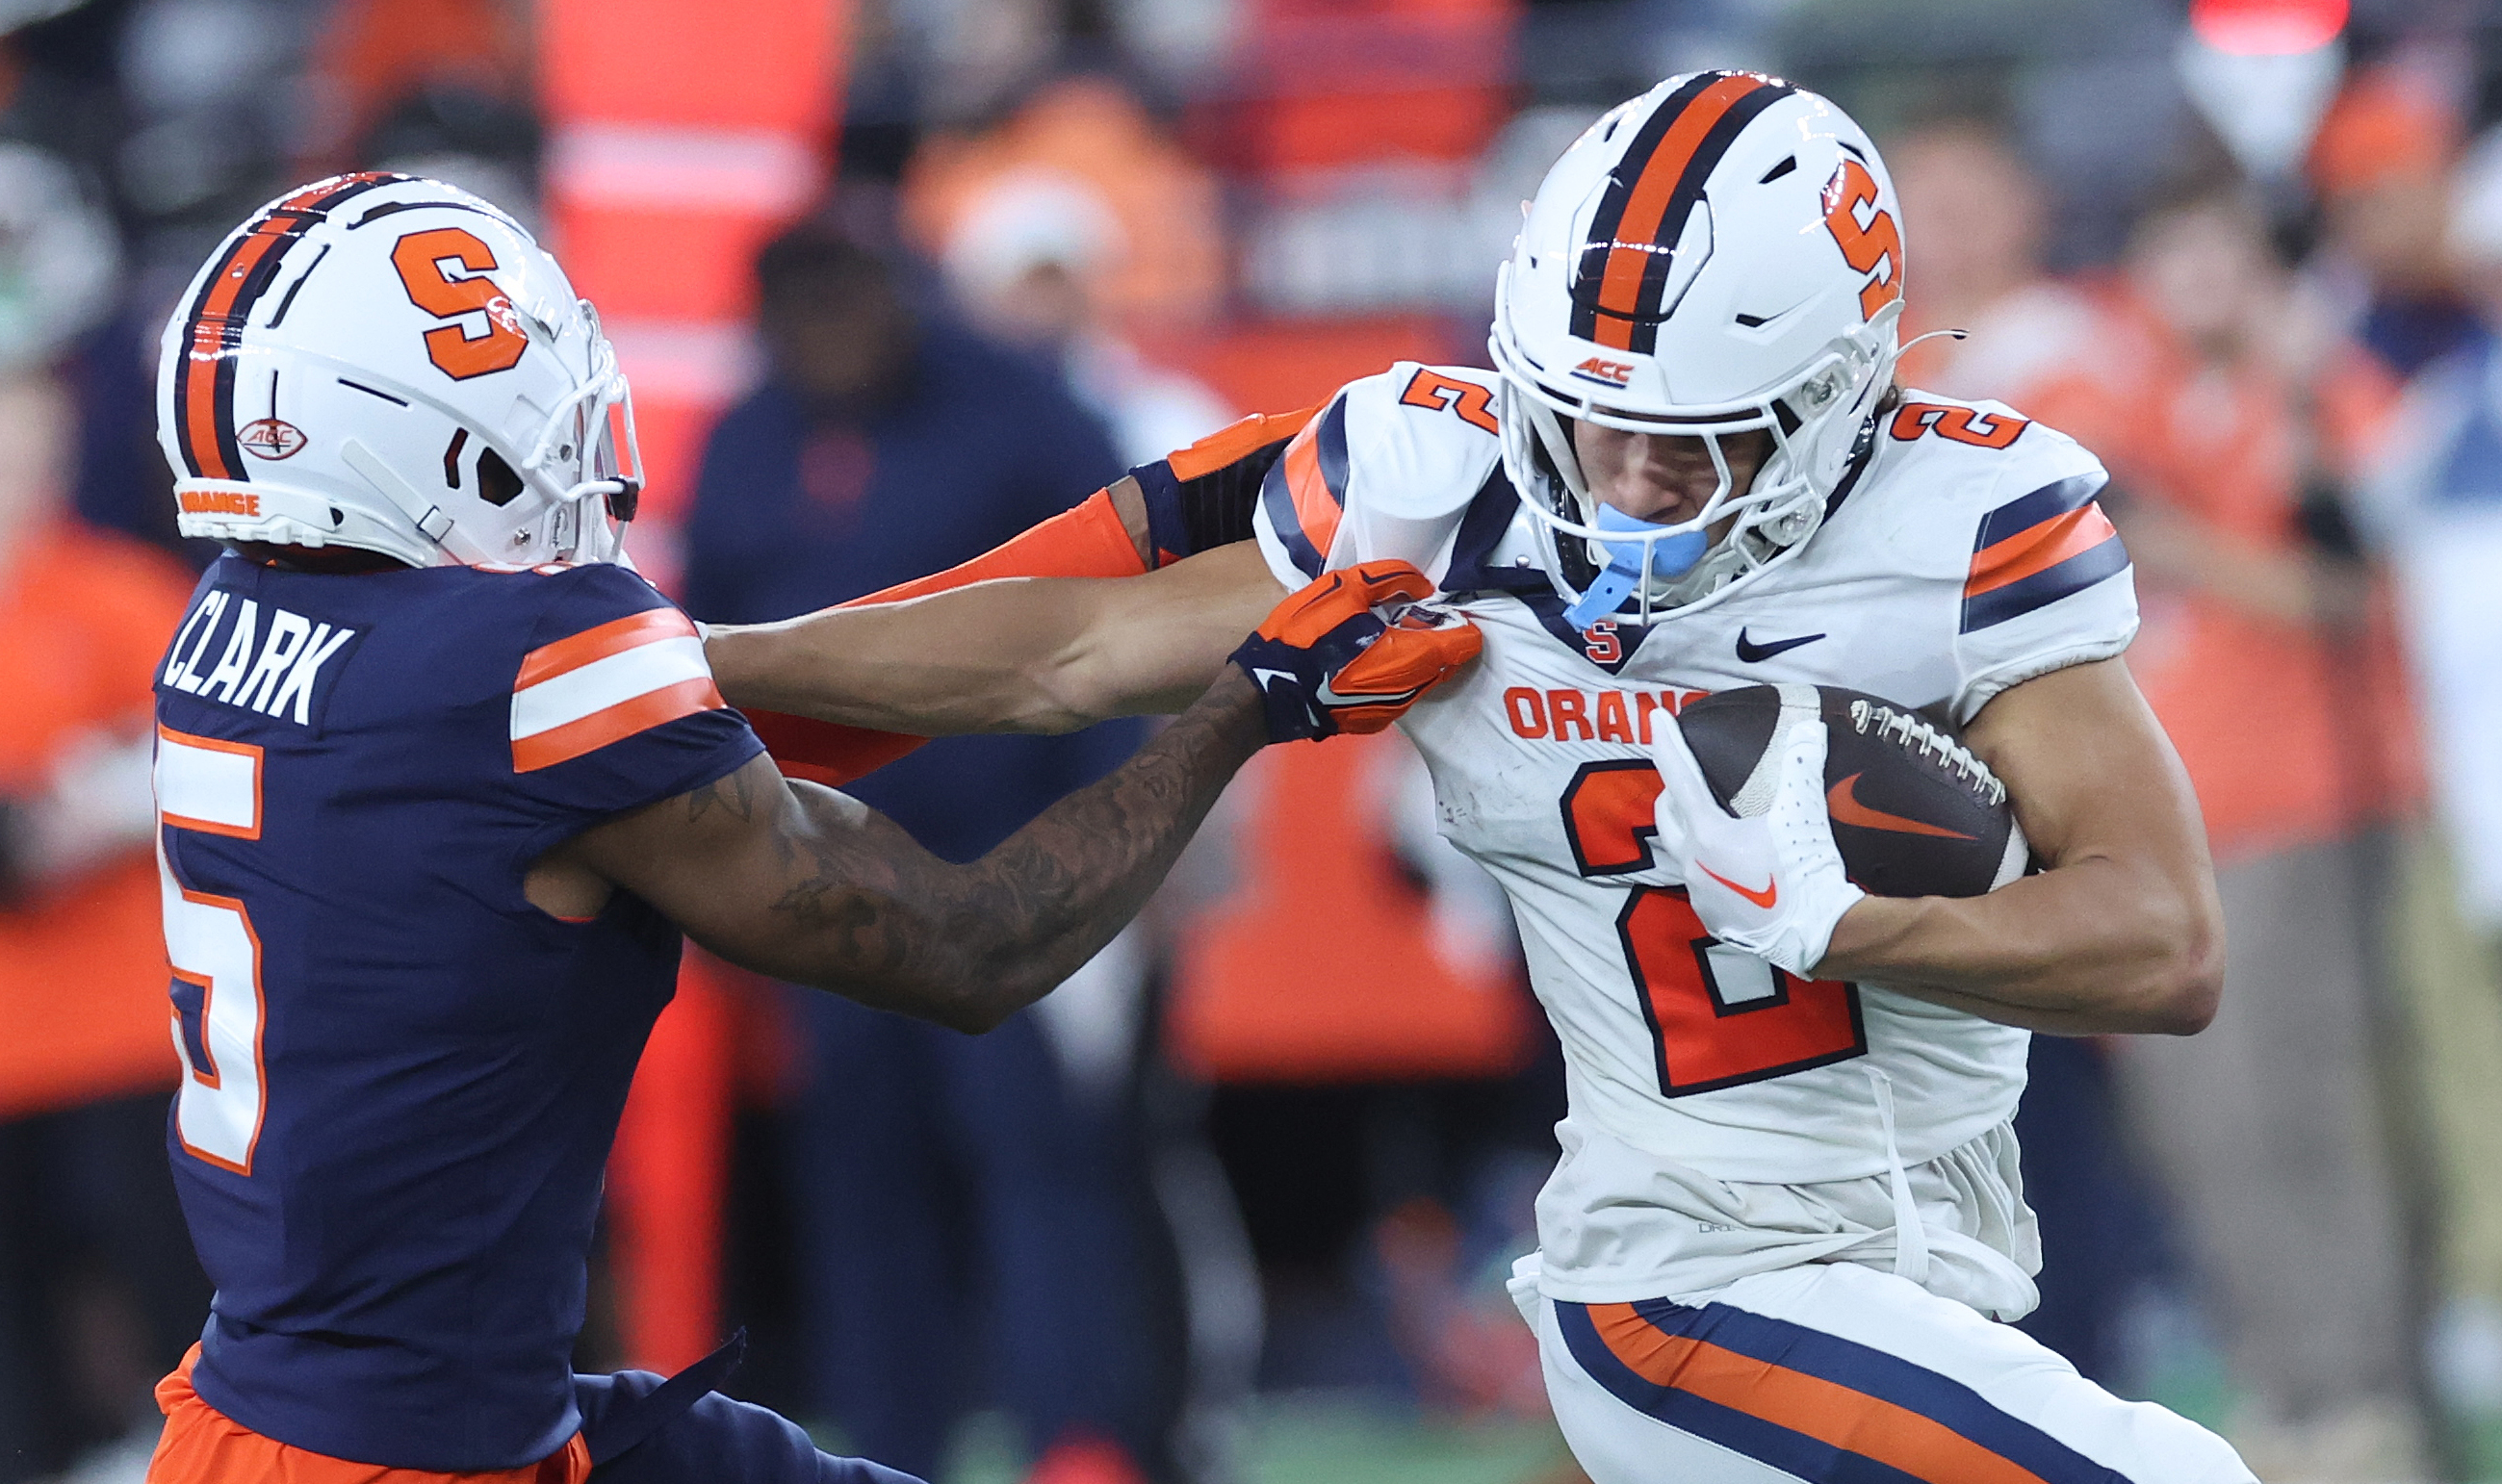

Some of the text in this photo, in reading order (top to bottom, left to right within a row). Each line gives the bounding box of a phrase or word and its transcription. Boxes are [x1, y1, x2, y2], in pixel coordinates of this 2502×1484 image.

[1820, 159, 1902, 323] S
[390, 226, 529, 381] S
[1399, 368, 1500, 437] 2
[1575, 357, 1635, 382] ACC
[1890, 402, 2032, 450] 2
[164, 590, 355, 726] CLARK
[1582, 619, 1622, 663] S
[1504, 686, 1713, 745] ORAN
[151, 722, 265, 1177] 5
[1560, 758, 1868, 1099] 2
